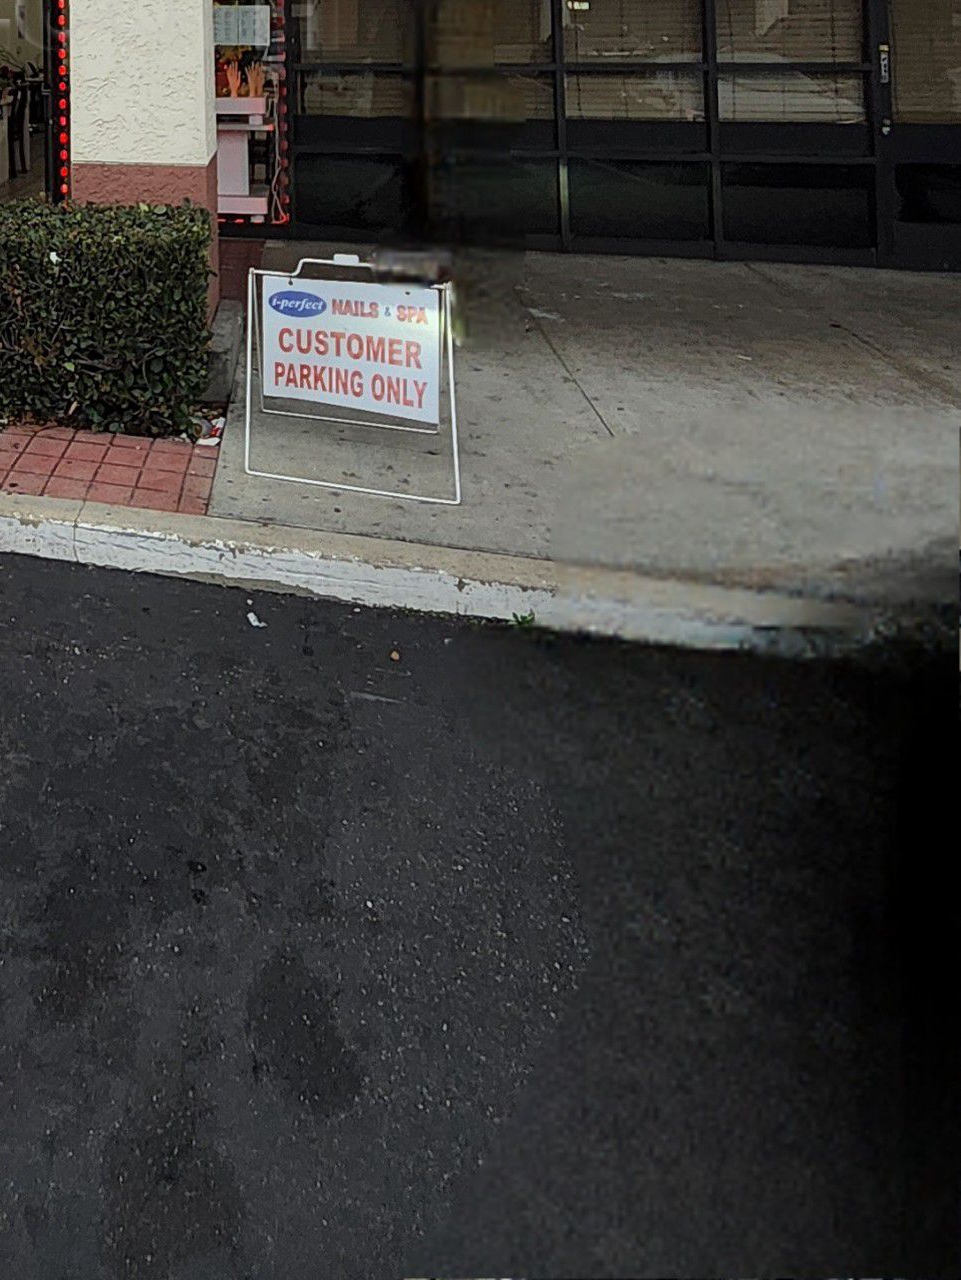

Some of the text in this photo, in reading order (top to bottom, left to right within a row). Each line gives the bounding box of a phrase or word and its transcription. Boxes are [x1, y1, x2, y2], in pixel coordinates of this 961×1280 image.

[271, 296, 429, 325] i-perfect NAILS & SPA
[278, 327, 423, 370] CUSTOMER
[274, 361, 428, 409] PARKING ONLY
